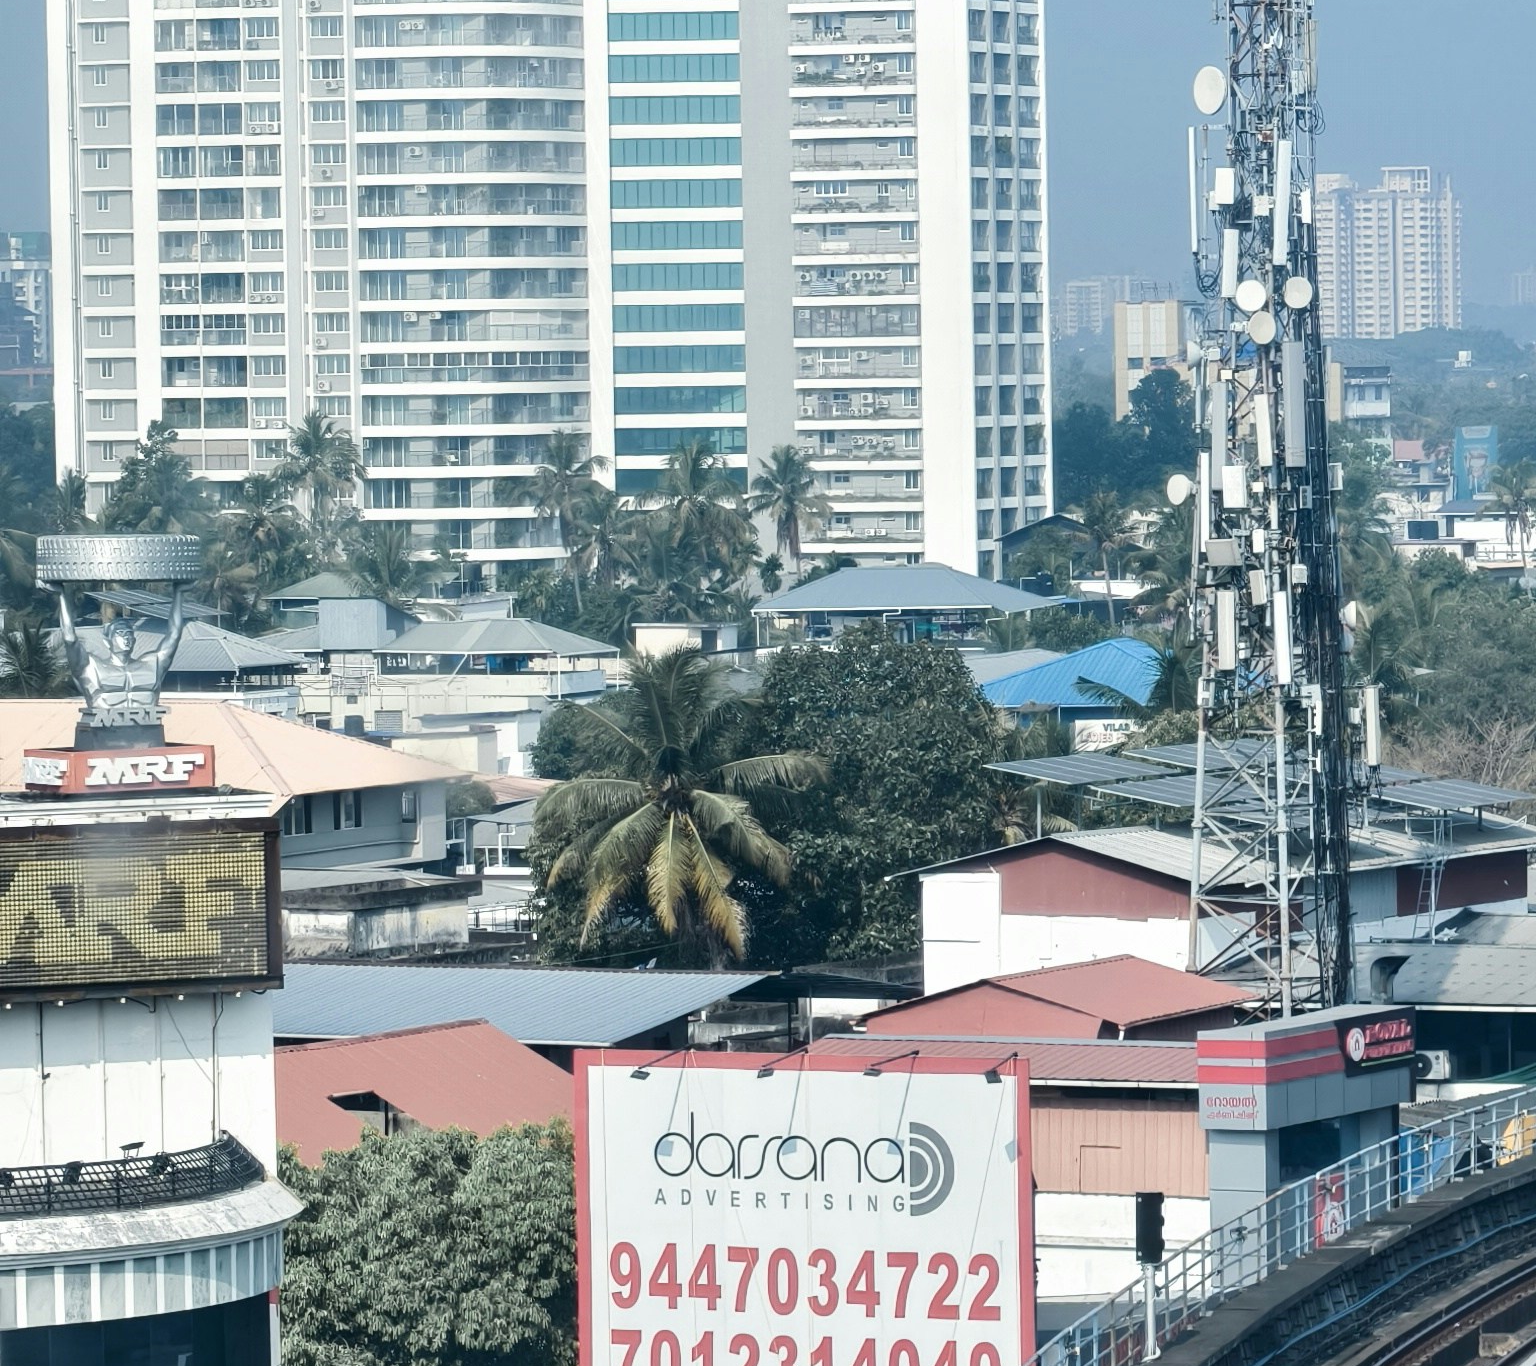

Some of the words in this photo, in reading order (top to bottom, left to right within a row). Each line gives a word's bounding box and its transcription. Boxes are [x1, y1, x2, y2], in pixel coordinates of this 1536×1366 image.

[91, 708, 168, 727] MRF
[85, 753, 204, 786] MRF
[654, 1111, 906, 1184] darsana
[655, 1187, 906, 1213] ADVERTISING
[609, 1241, 1002, 1322] 9447034722
